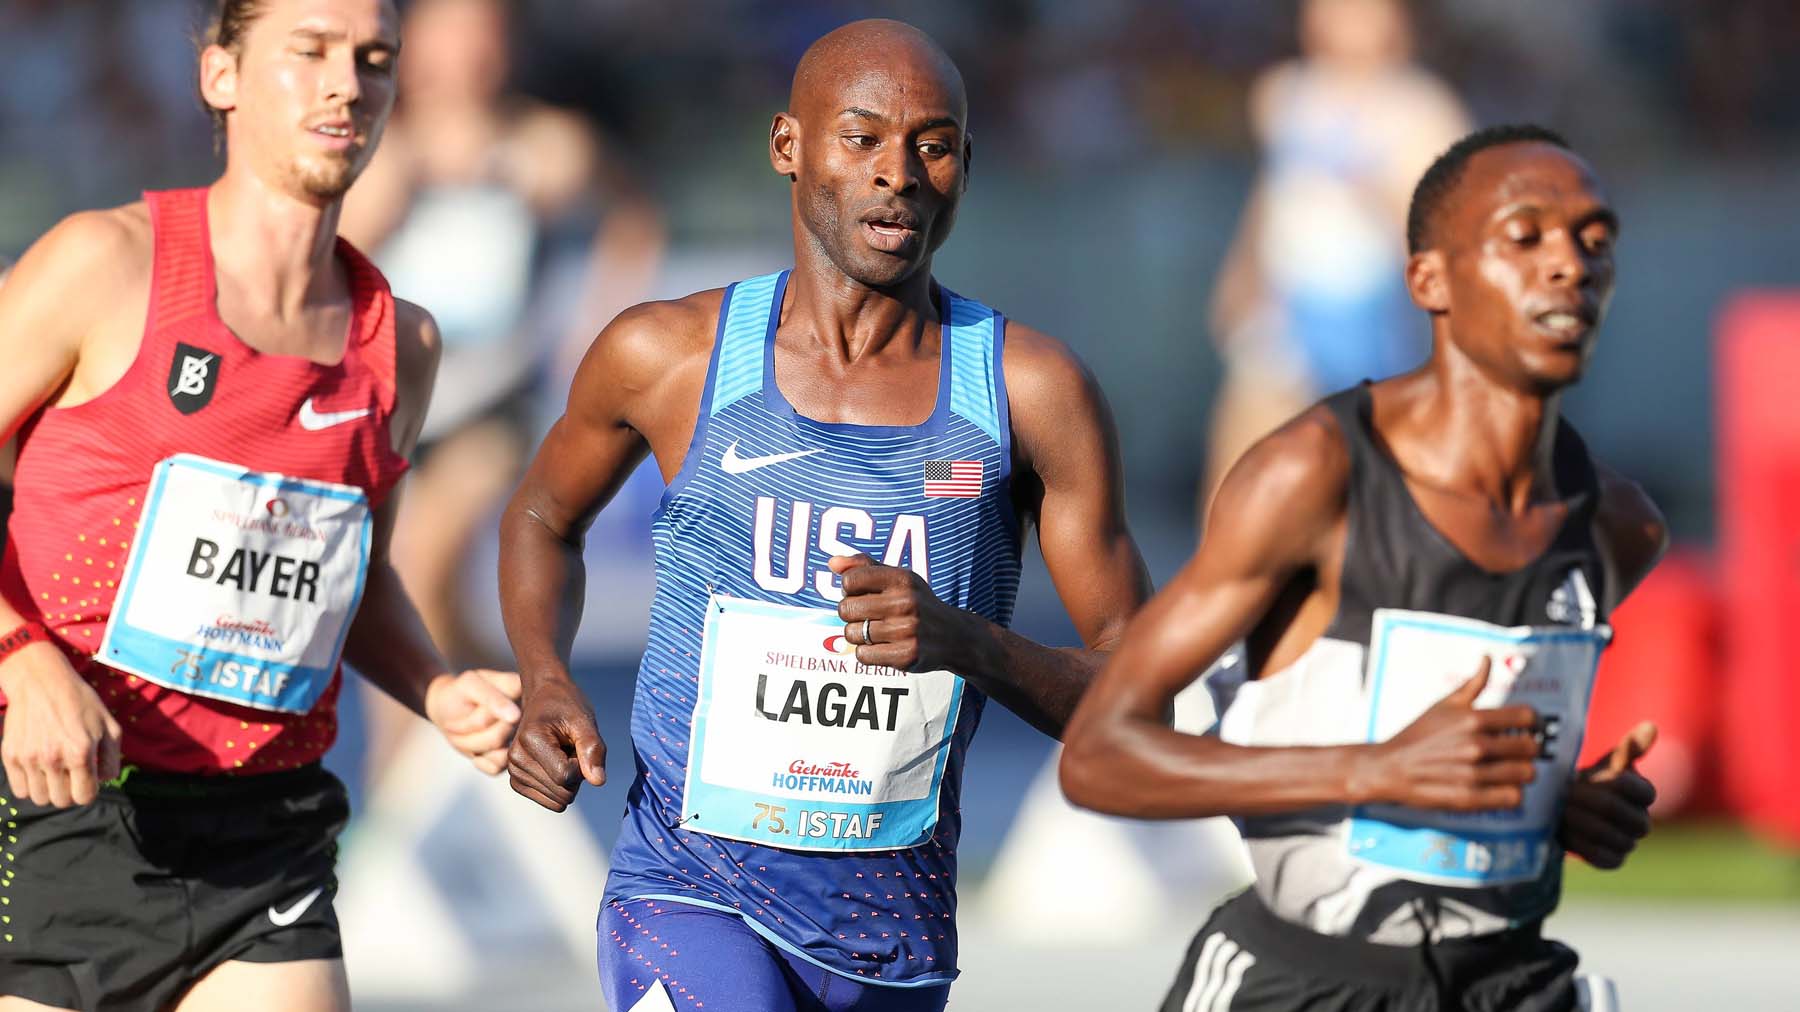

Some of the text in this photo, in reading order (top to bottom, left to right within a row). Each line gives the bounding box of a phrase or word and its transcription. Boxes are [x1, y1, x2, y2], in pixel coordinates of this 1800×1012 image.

[752, 496, 931, 603] USA
[186, 537, 320, 603] BAYER
[210, 660, 290, 698] ISTAF
[766, 651, 848, 674] SPIELBANK
[755, 673, 909, 732] LAGAT
[772, 772, 873, 796] HOFFMANN
[752, 802, 884, 839] 75. ISTAF
